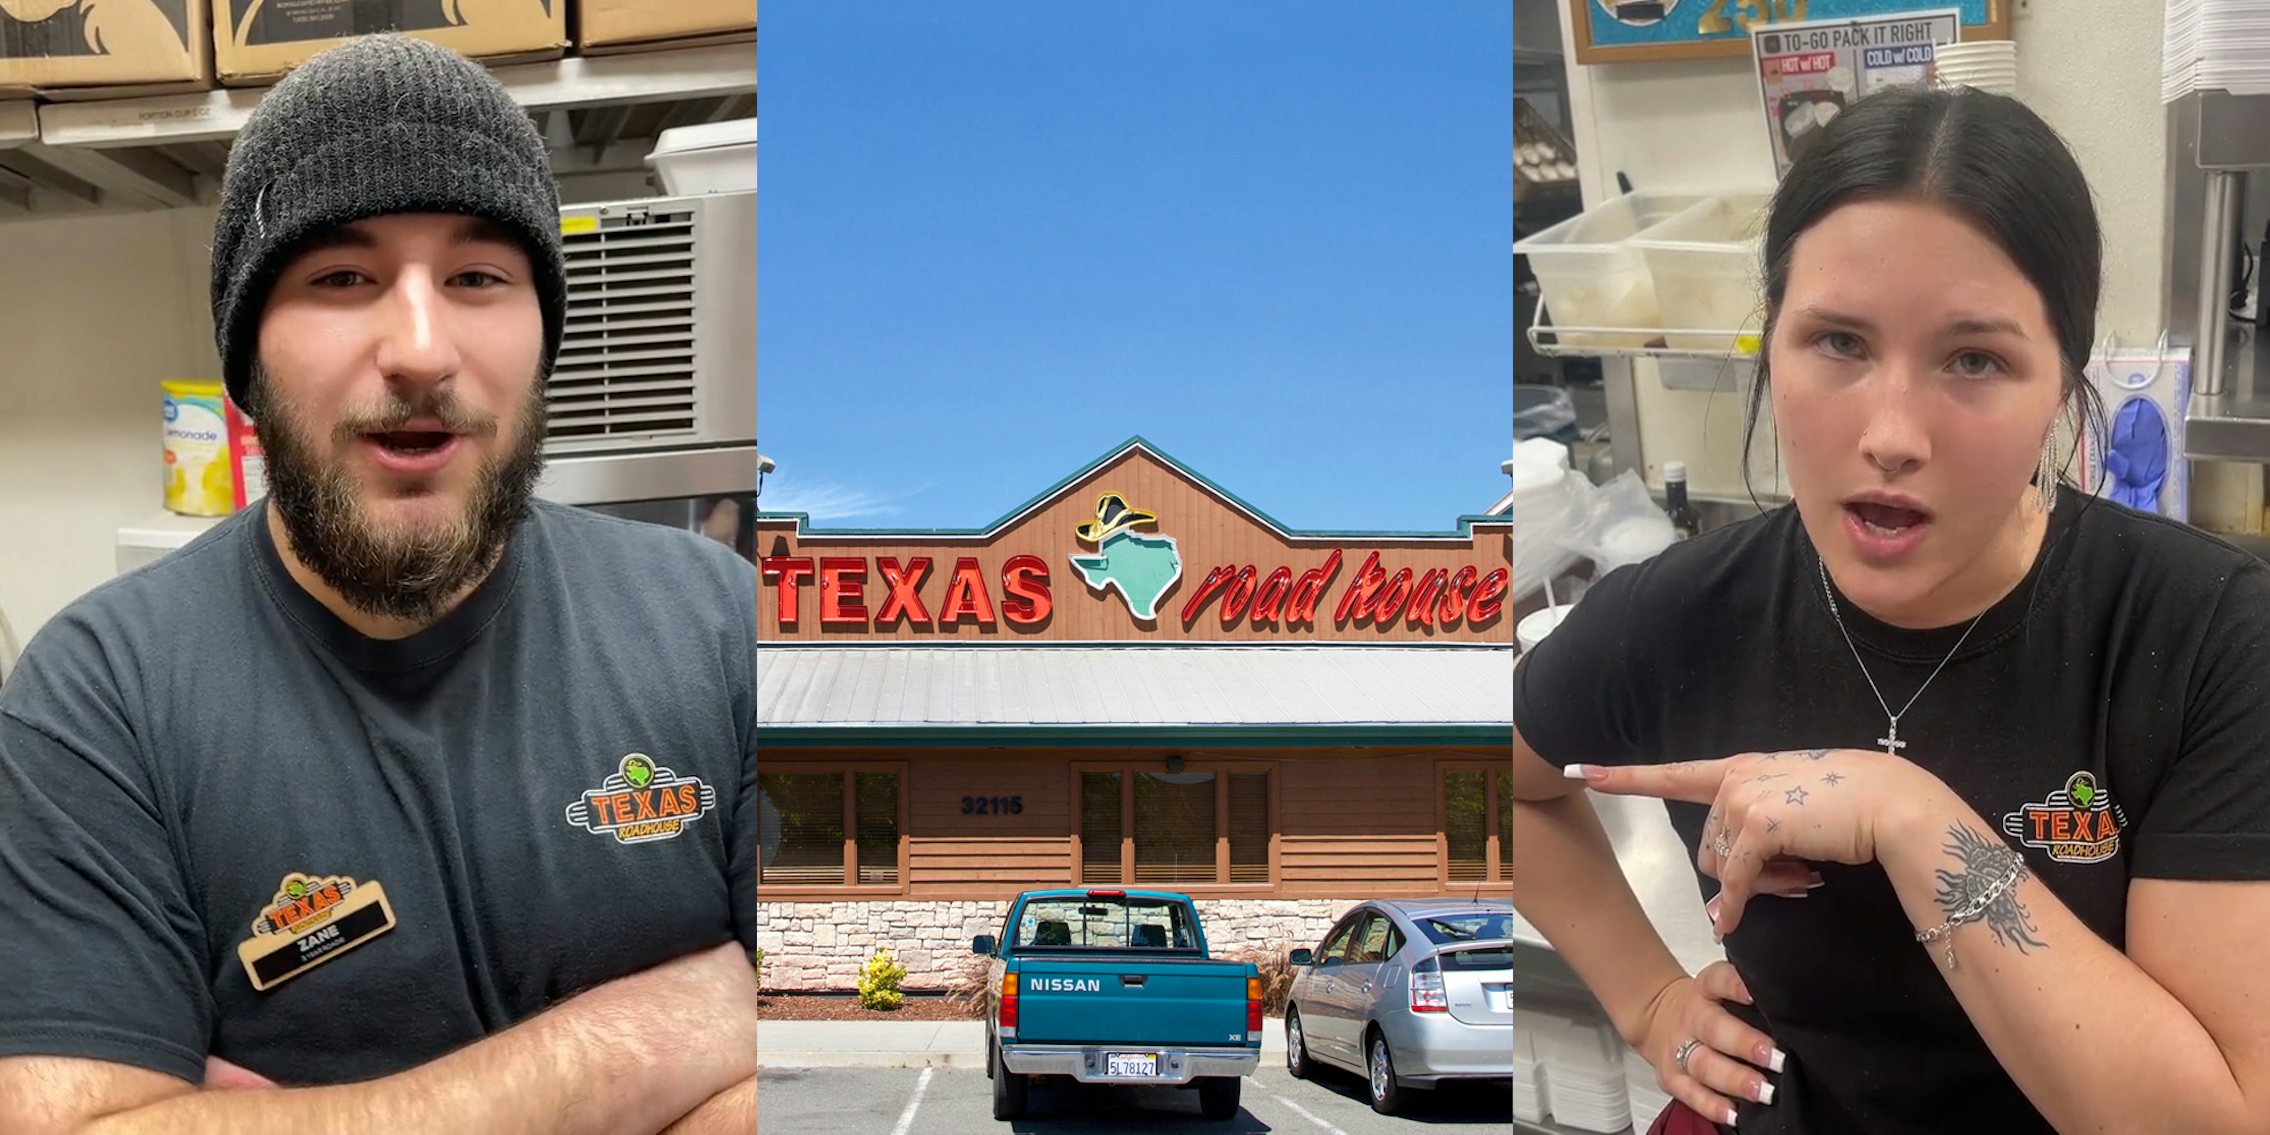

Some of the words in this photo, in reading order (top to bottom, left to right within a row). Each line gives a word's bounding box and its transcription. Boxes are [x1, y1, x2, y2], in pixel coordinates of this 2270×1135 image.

[1784, 31, 1829, 52] TO-GO
[1833, 27, 1870, 48] PACK
[1874, 25, 1885, 45] IT
[1891, 22, 1933, 44] RIGHT
[1781, 57, 1800, 72] HOT
[1799, 56, 1813, 71] w/
[1813, 54, 1832, 70] HOT
[1866, 50, 1893, 66] COLD
[1893, 48, 1906, 63] w/
[1906, 46, 1932, 62] COLD
[762, 554, 1053, 625] TEXAS
[1181, 547, 1344, 624] road
[1334, 549, 1509, 627] house
[591, 784, 698, 825] TEXAS
[961, 795, 1023, 815] 32115
[619, 820, 680, 838] ROADHOUSE
[2029, 811, 2116, 841] TEXA
[2052, 841, 2115, 857] ROADHOUSE
[269, 884, 341, 929] TEXAS
[297, 924, 341, 952] ZANE
[1030, 978, 1101, 992] NISSAN
[1228, 1034, 1242, 1042] XE
[1109, 1061, 1154, 1076] 5L78127
